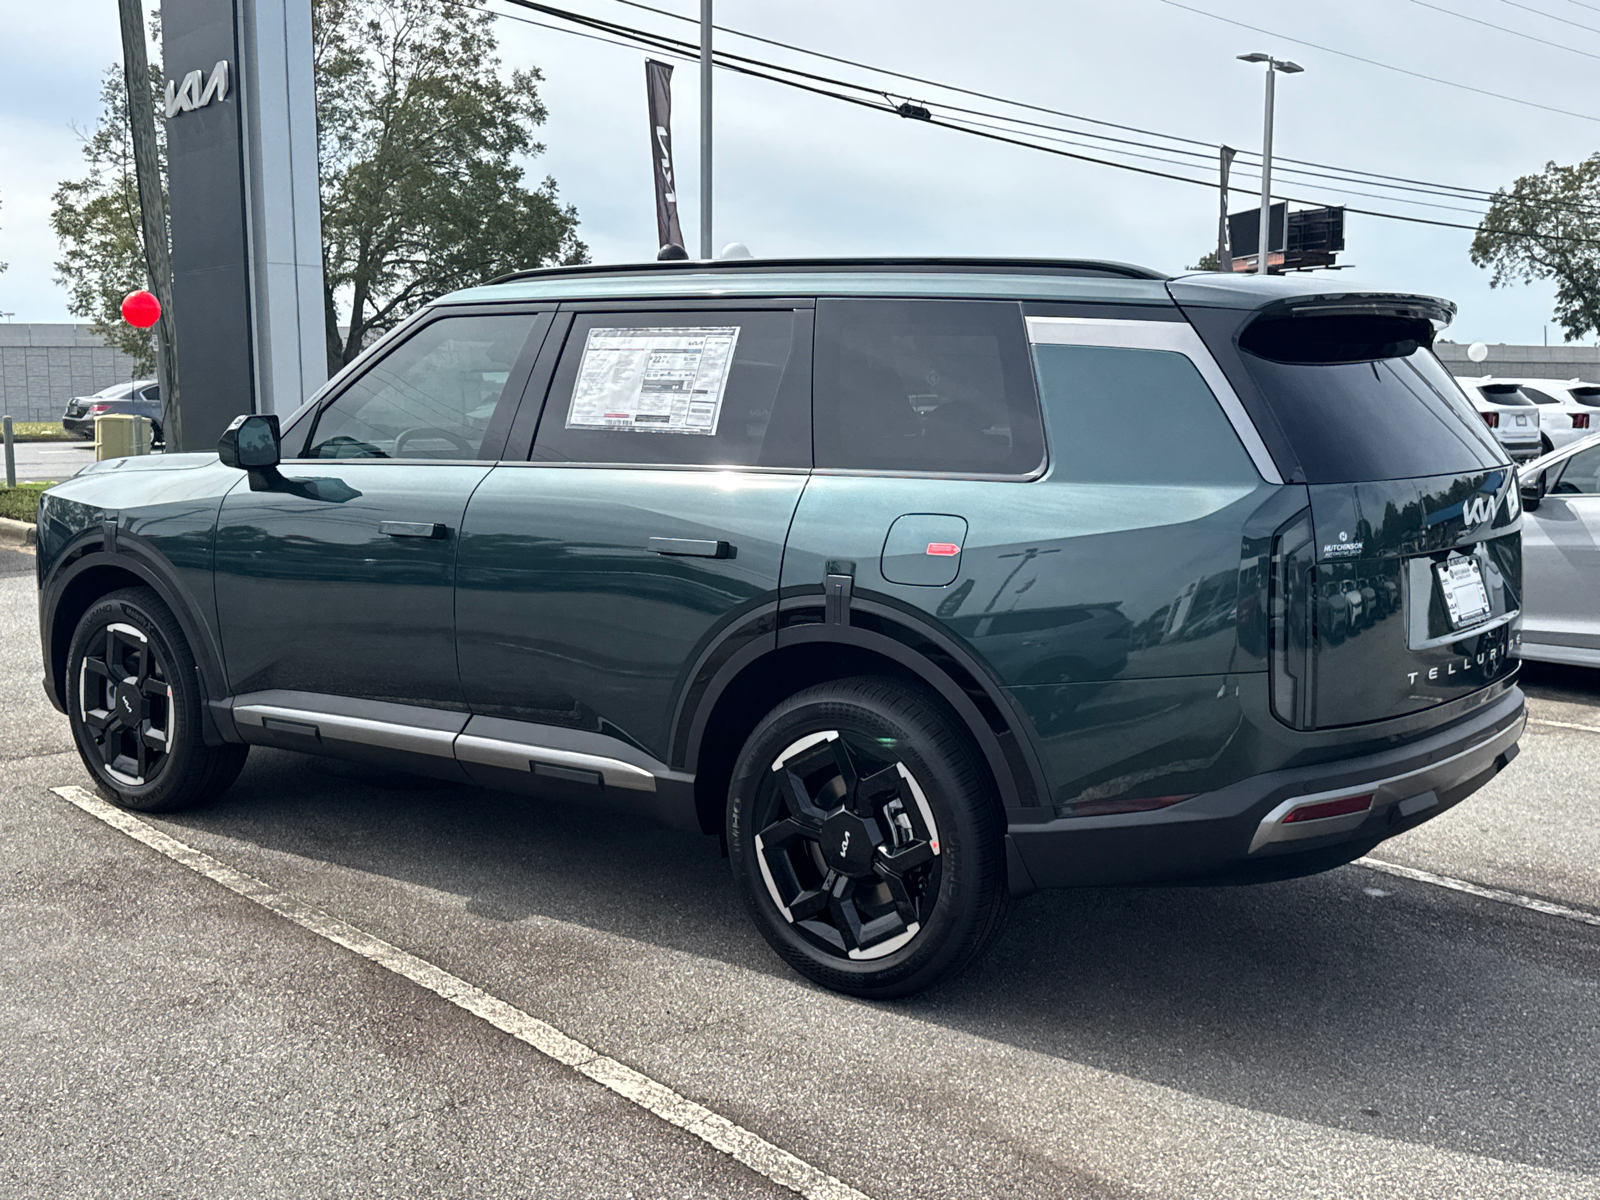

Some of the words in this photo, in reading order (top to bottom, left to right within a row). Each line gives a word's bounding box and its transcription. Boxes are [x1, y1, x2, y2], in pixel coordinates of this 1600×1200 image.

[164, 60, 229, 118] KIA
[652, 355, 662, 363] 22
[1463, 495, 1495, 526] KIA
[1323, 542, 1363, 553] HUTCHINSON
[1407, 633, 1521, 686] TELLURIDE
